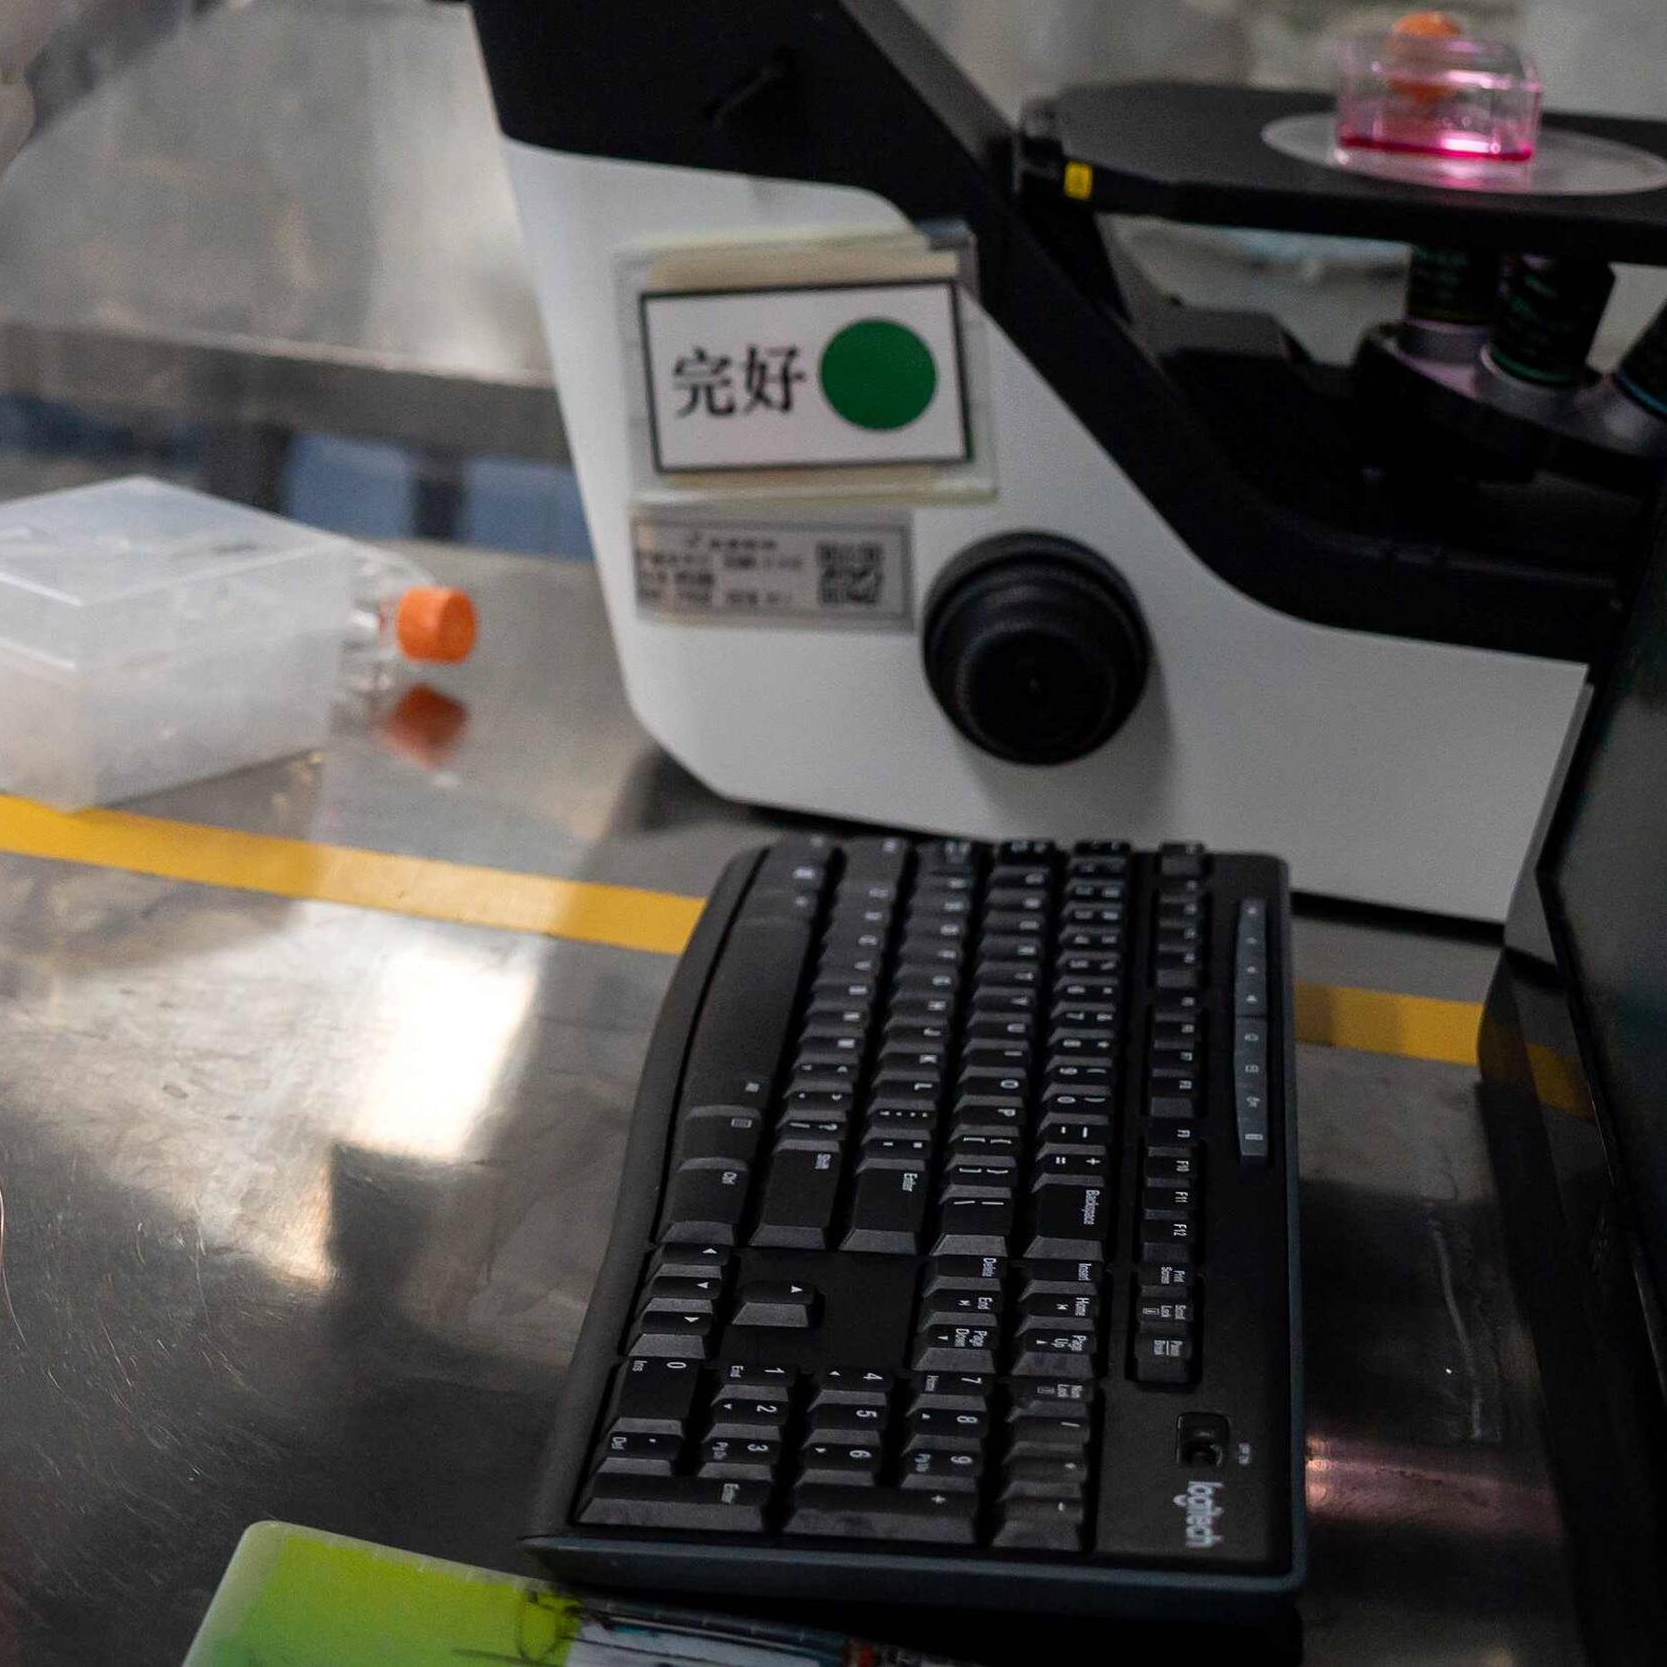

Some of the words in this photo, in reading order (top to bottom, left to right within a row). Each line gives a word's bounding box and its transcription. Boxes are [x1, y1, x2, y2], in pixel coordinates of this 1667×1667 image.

[671, 345, 807, 417] 完好
[998, 1109, 1016, 1117] P
[1176, 1160, 1189, 1172] F10
[902, 1173, 918, 1192] Enter
[1175, 1191, 1188, 1203] F11
[1081, 1190, 1100, 1225] Backspace
[1173, 1224, 1187, 1236] F12
[981, 1256, 999, 1279] Delete
[1078, 1263, 1092, 1281] Insert
[977, 1297, 993, 1310] End
[1075, 1297, 1089, 1316] Home
[955, 1328, 972, 1347] Down
[968, 1329, 988, 1347] Page
[1051, 1338, 1070, 1348] Up
[1067, 1335, 1087, 1351] Page
[632, 1360, 647, 1372] Ins
[730, 1365, 744, 1378] End
[756, 1405, 777, 1413] 2
[957, 1415, 978, 1423] 8
[611, 1437, 627, 1450] Del
[849, 1450, 871, 1458] 6
[950, 1456, 972, 1464] 9
[1173, 1481, 1223, 1547] logitech
